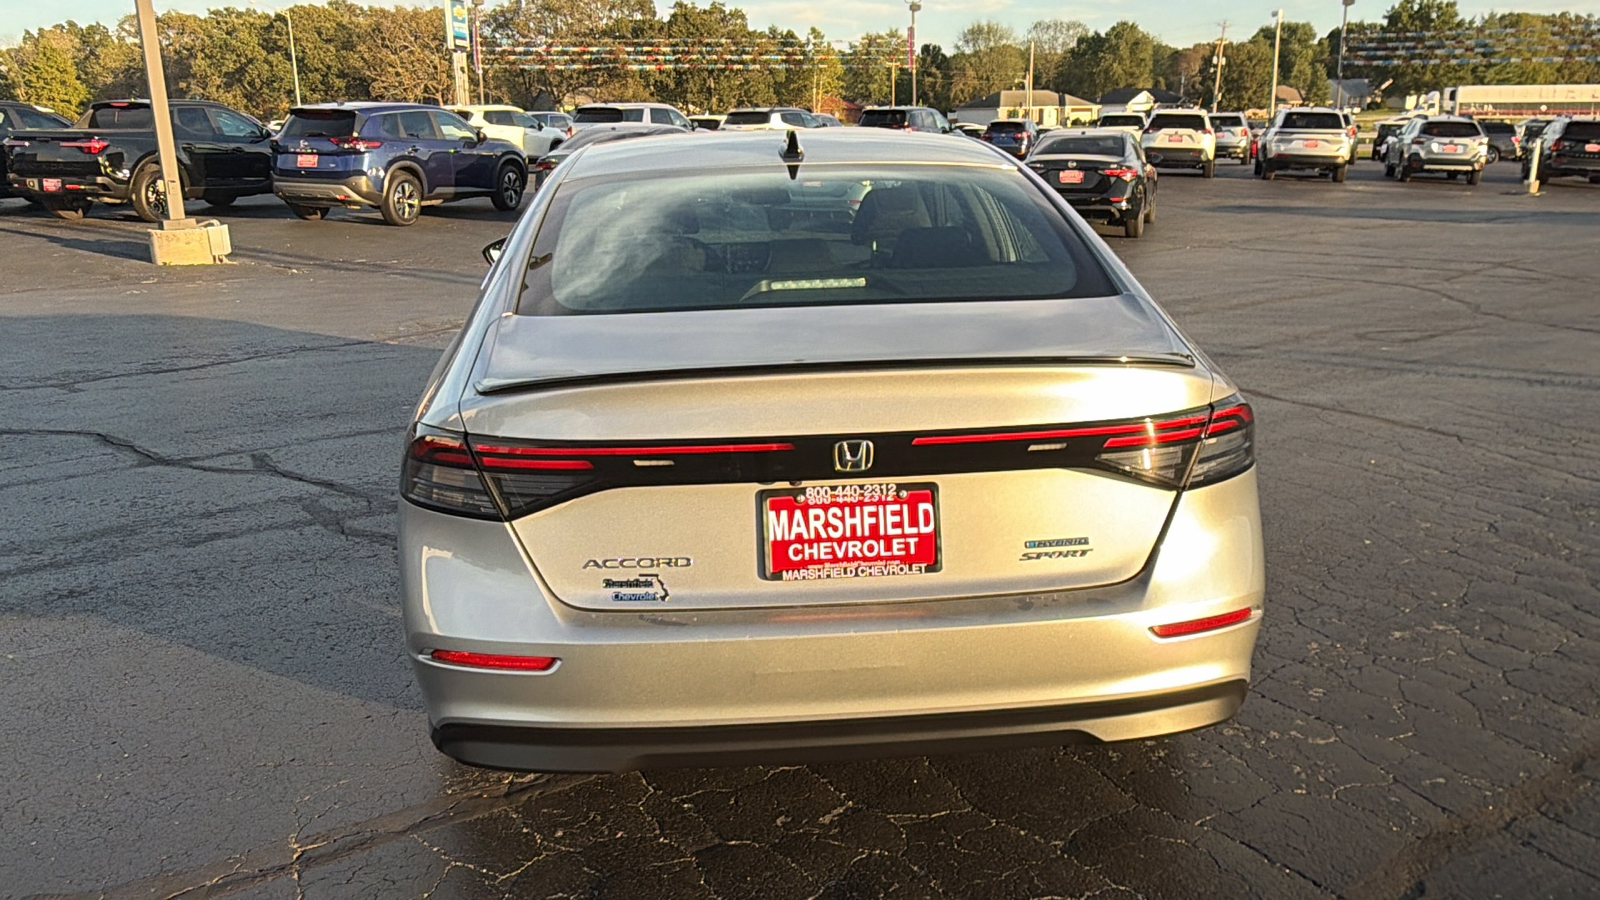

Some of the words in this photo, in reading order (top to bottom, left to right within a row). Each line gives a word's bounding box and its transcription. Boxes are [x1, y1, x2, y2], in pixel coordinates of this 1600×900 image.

[805, 484, 897, 499] 800-440-2312
[769, 502, 935, 541] MARSHFIELD
[788, 537, 919, 561] CHEVROLET
[1019, 548, 1094, 561] SPORT
[582, 557, 692, 569] ACCORD
[782, 567, 855, 581] MARSHFIELD
[857, 563, 928, 578] CHEVROLET
[612, 591, 659, 601] Chevrolet
